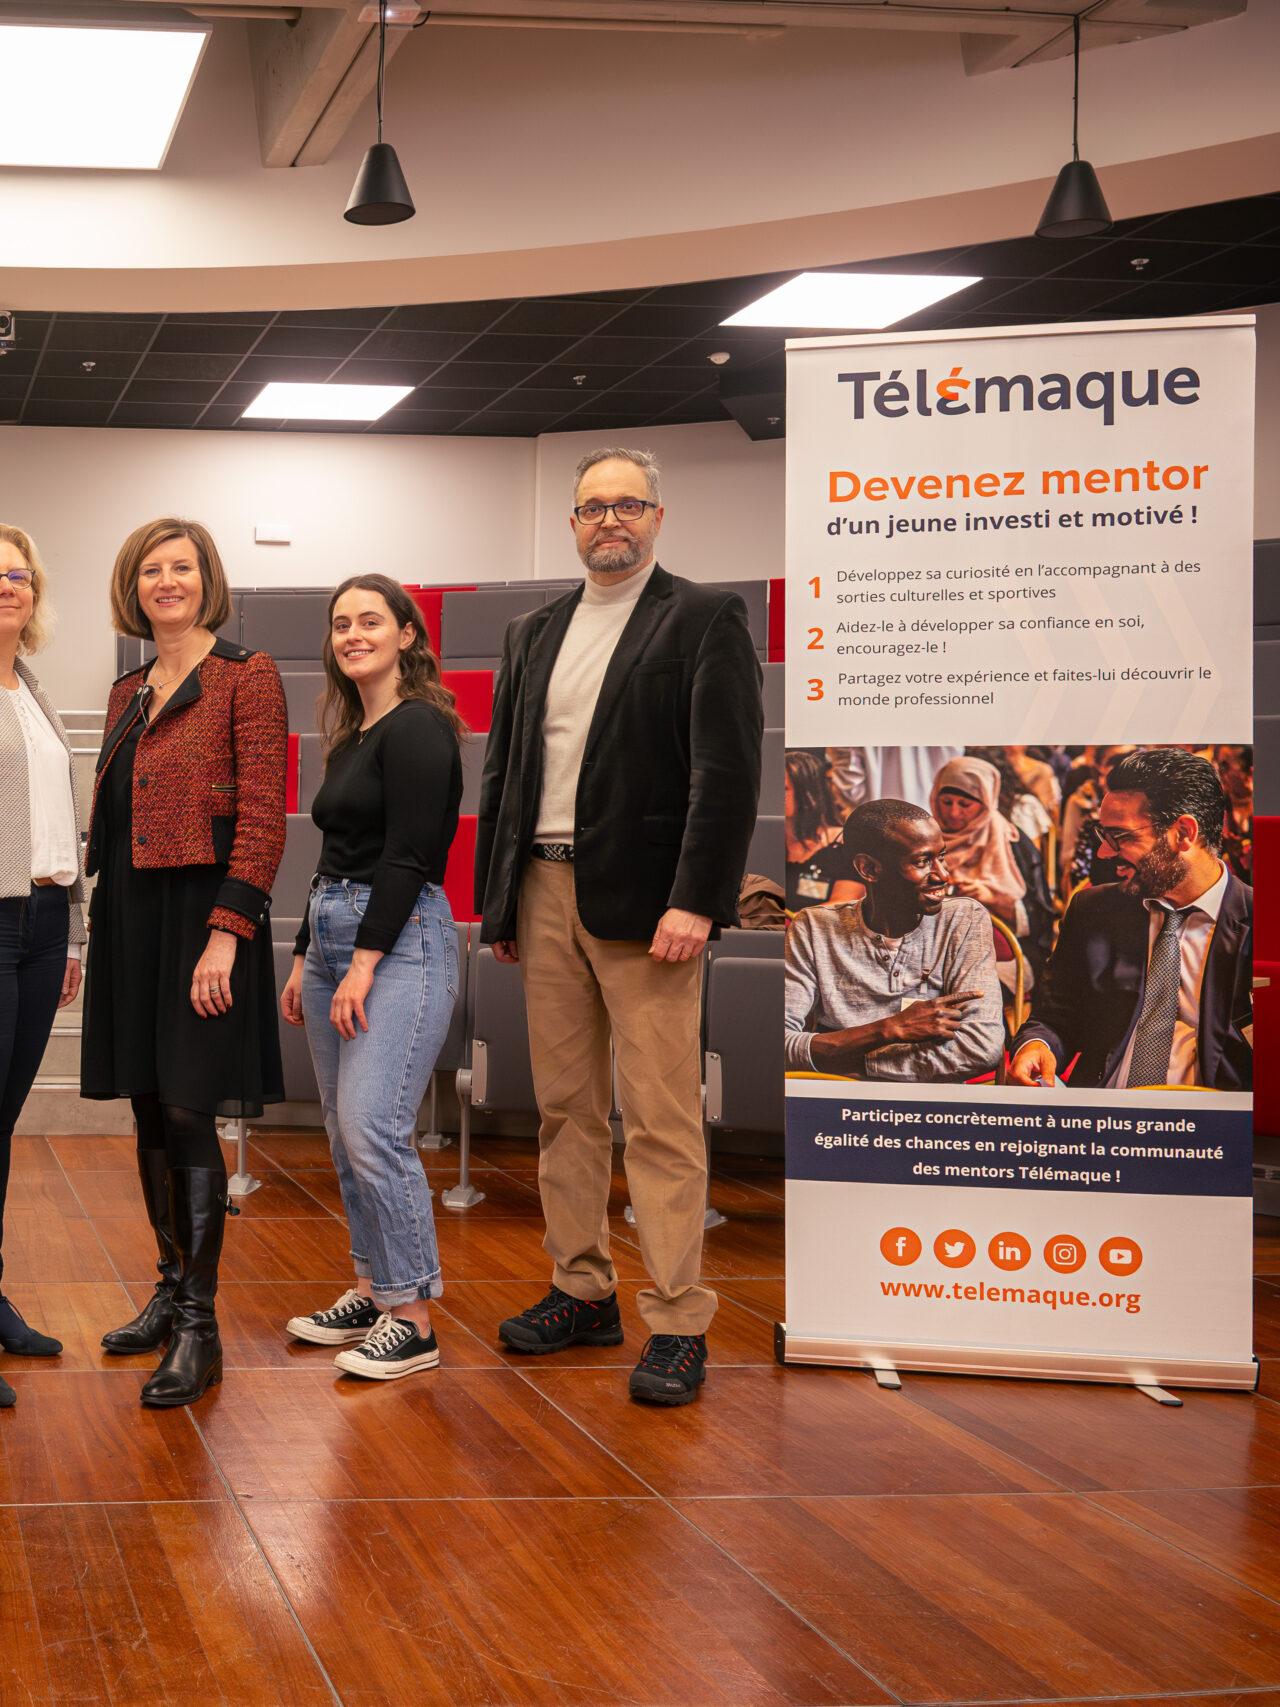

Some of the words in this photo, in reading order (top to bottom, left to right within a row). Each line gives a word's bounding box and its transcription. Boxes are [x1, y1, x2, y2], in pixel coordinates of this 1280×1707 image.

[838, 367, 1200, 425] Télémaque
[830, 472, 1024, 502] Devenez
[1043, 461, 1208, 494] mentor
[886, 515, 956, 538] jeune
[966, 510, 1049, 531] investi
[1059, 511, 1083, 527] et
[1093, 505, 1183, 526] motivé
[1192, 506, 1196, 523] !
[838, 569, 921, 583] Développez
[927, 571, 941, 579] sa
[946, 565, 1009, 579] curiosité
[1015, 568, 1032, 576] en
[1161, 561, 1169, 573] à
[1175, 561, 1200, 572] des
[809, 577, 820, 598] 1
[837, 593, 885, 603] sorties
[890, 589, 964, 601] culturelles
[969, 590, 983, 600] et
[988, 587, 1056, 602] sportives
[836, 620, 893, 633] Aidez-le
[899, 620, 906, 631] à
[911, 620, 994, 634] développer
[999, 621, 1014, 629] sa
[1020, 617, 1090, 629] confiance
[1095, 619, 1113, 628] en
[1119, 615, 1144, 628] soi,
[808, 628, 824, 649] 2
[837, 641, 938, 656] encouragez-le
[943, 641, 946, 653] !
[839, 673, 901, 687] Partagez
[906, 673, 942, 683] votre
[947, 671, 1029, 686] expérience
[1035, 671, 1048, 681] et
[1053, 669, 1115, 681] faites-lui
[1121, 667, 1194, 680] découvrir
[1200, 667, 1211, 679] le
[807, 679, 824, 701] 3
[839, 694, 889, 705] monde
[895, 692, 993, 708] professionnel
[842, 1109, 921, 1126] Participez
[926, 1112, 1042, 1127] concrètement
[1047, 1115, 1055, 1127] à
[1061, 1119, 1091, 1128] une
[1097, 1117, 1132, 1132] plus
[1136, 1119, 1195, 1134] grande
[815, 1133, 869, 1149] égalité
[874, 1135, 901, 1148] des
[906, 1136, 970, 1150] chances
[975, 1141, 994, 1151] en
[1001, 1140, 1086, 1157] rejoignant
[1091, 1142, 1105, 1155] la
[1111, 1146, 1223, 1159] communauté
[913, 1162, 940, 1175] des
[945, 1166, 1014, 1178] mentors
[1019, 1167, 1111, 1184] Télémaque
[1116, 1170, 1120, 1182] !
[880, 1282, 1141, 1313] www.telemaque.org
